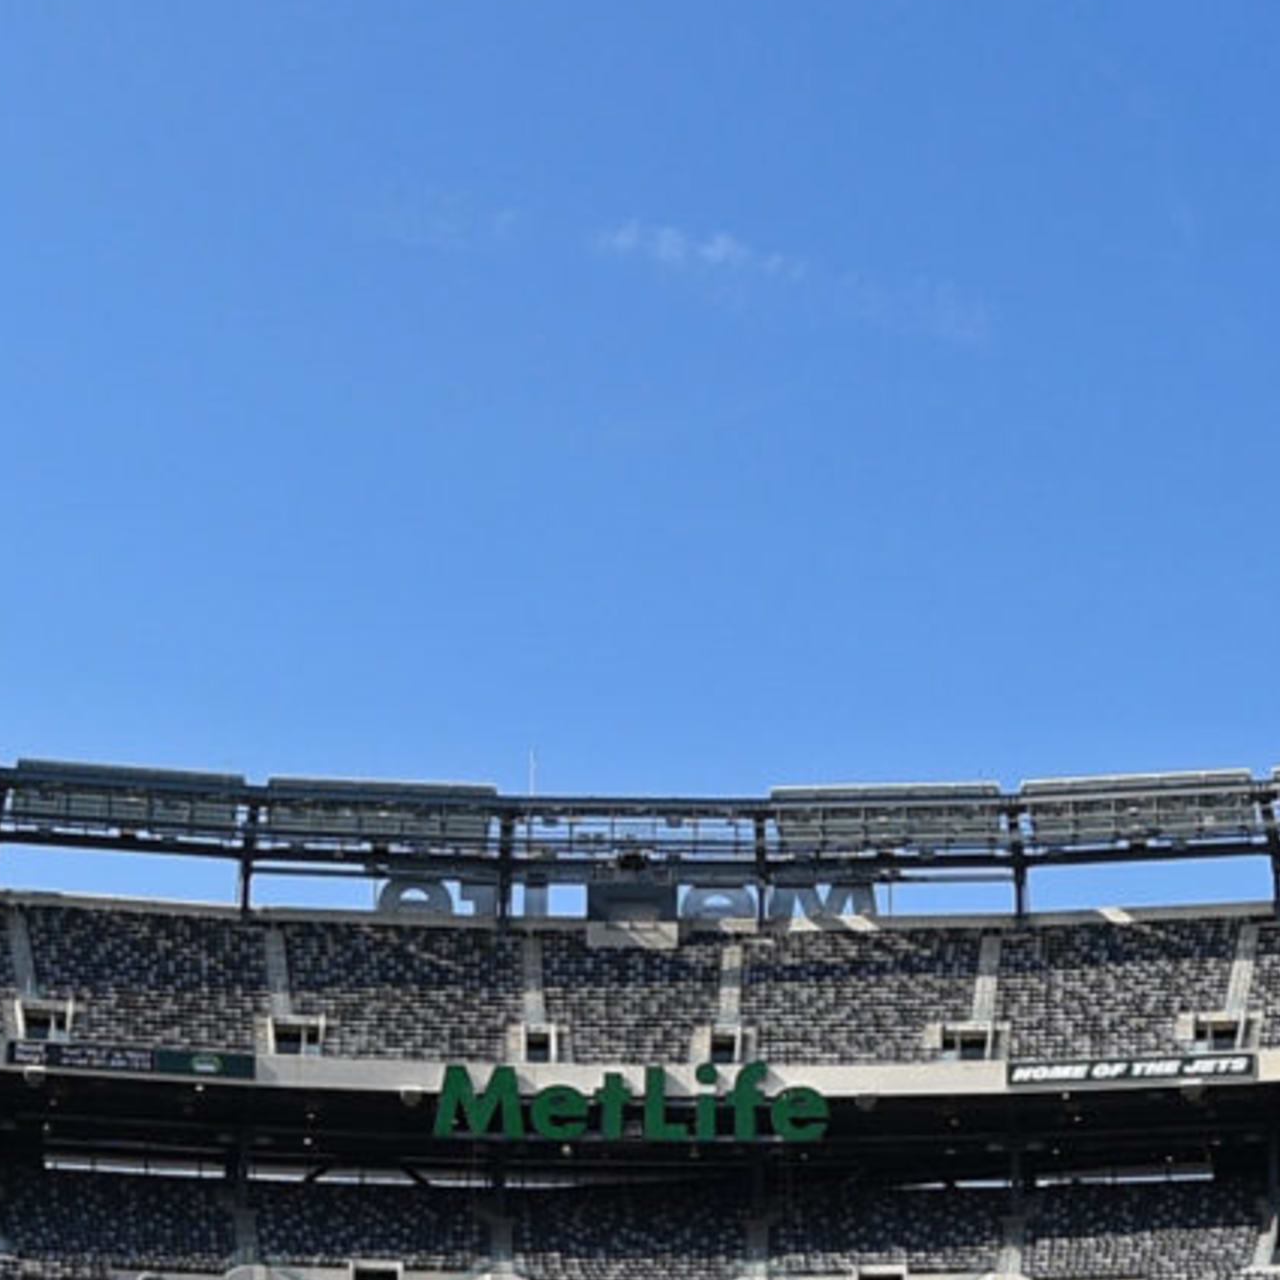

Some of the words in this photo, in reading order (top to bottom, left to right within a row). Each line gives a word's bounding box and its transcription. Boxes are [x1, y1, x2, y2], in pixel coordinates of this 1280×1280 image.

[1012, 1064, 1089, 1082] HOME
[1091, 1062, 1128, 1078] OF
[1131, 1060, 1182, 1076] THE
[1183, 1057, 1248, 1074] JETS
[433, 1060, 830, 1142] MetLife
